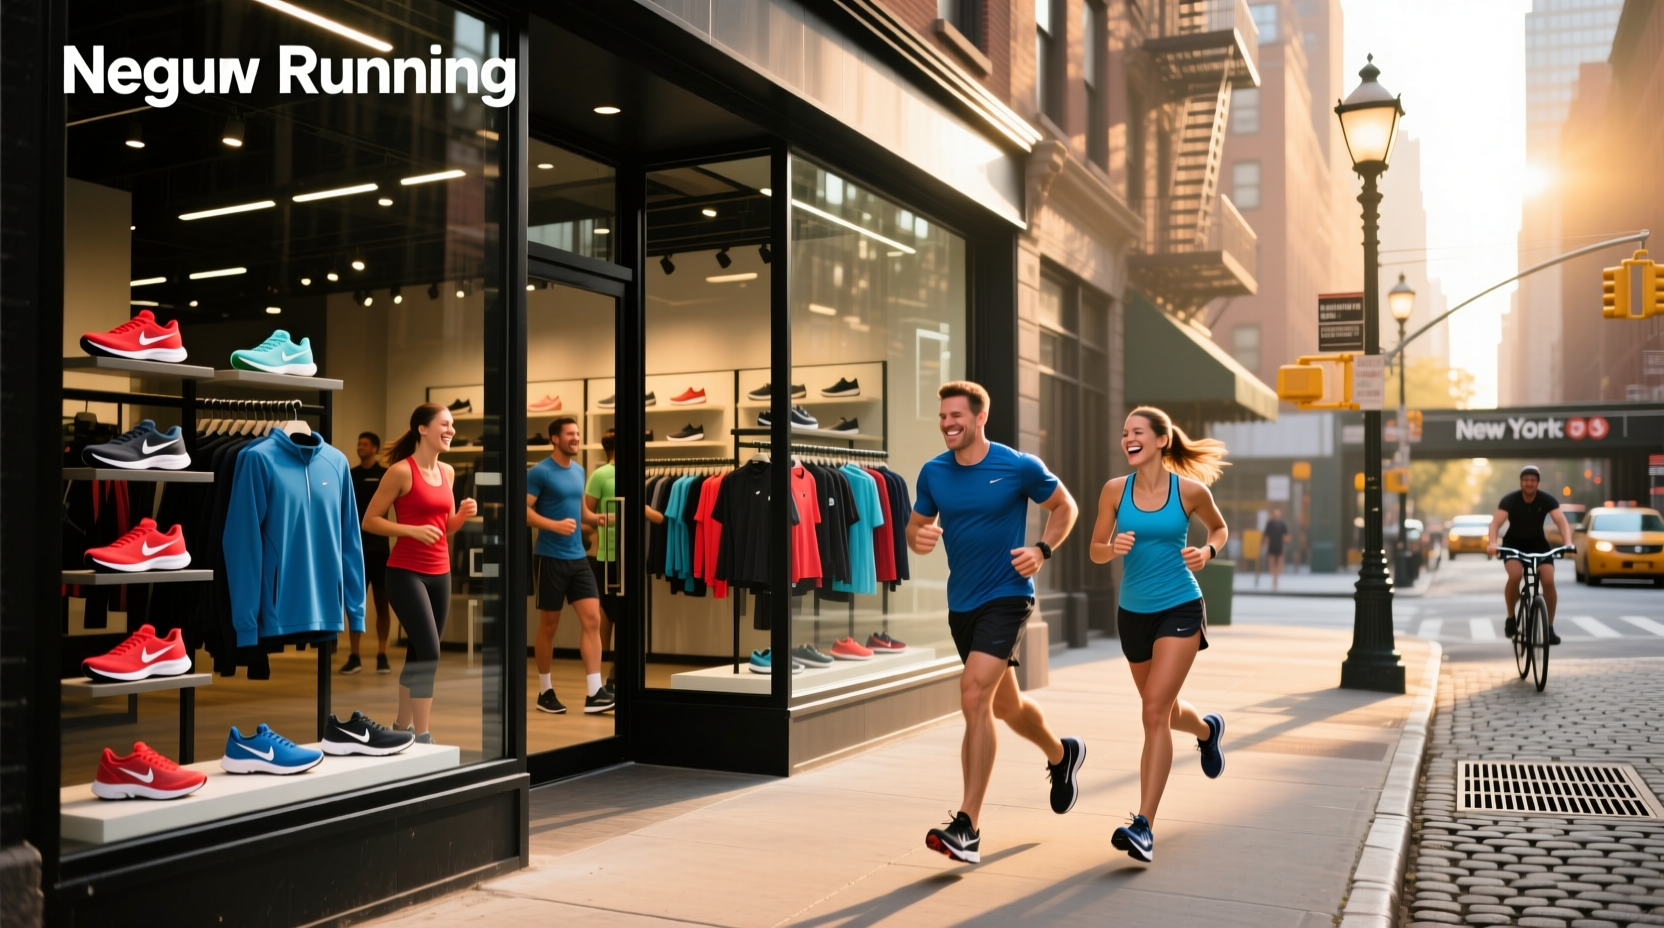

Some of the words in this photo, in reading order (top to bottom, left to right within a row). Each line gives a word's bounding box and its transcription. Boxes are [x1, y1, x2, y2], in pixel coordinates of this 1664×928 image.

[279, 44, 516, 108] Running
[1455, 418, 1506, 441] New
[1508, 416, 1564, 440] York
